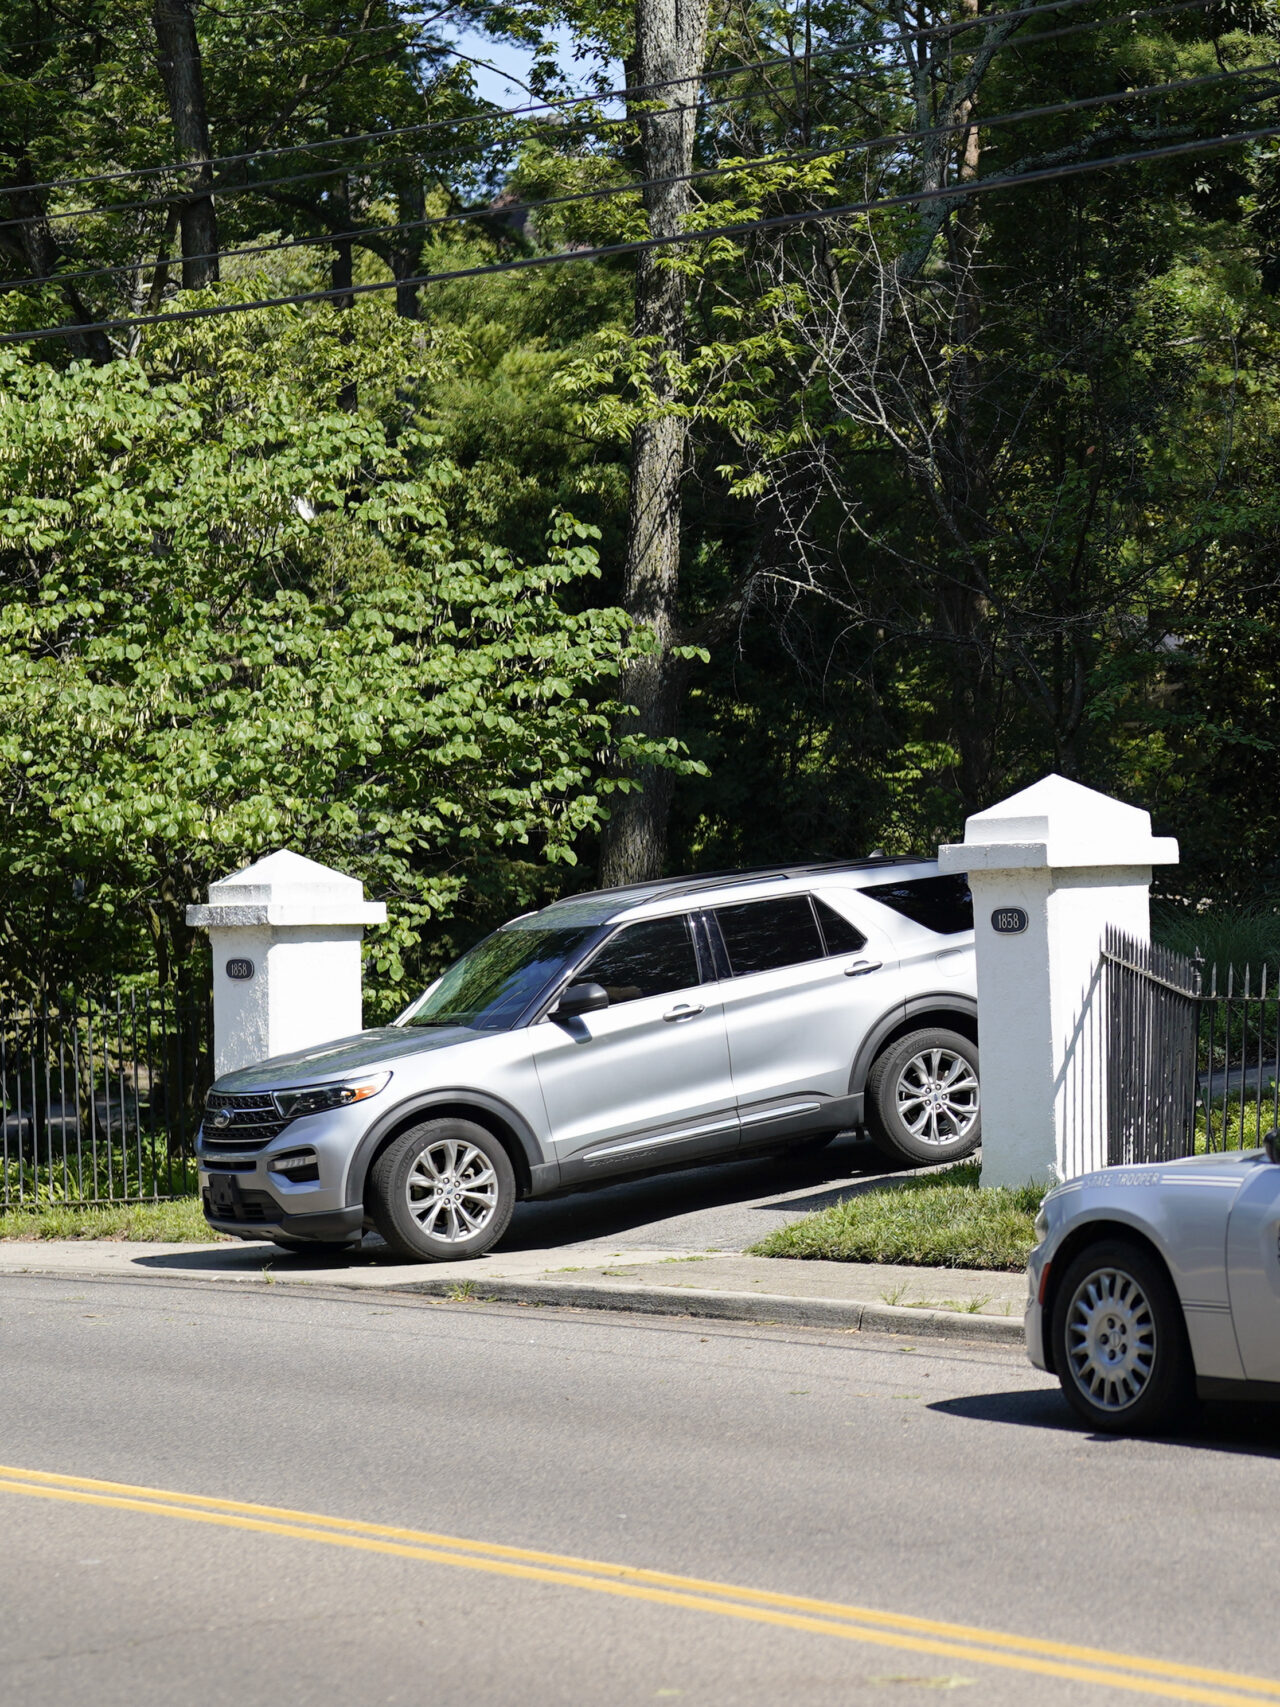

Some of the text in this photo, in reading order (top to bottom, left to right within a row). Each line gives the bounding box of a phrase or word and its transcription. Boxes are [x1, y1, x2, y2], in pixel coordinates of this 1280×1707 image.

[998, 912, 1020, 929] 1858
[231, 963, 248, 976] 1858
[1117, 1171, 1160, 1187] TROOPER
